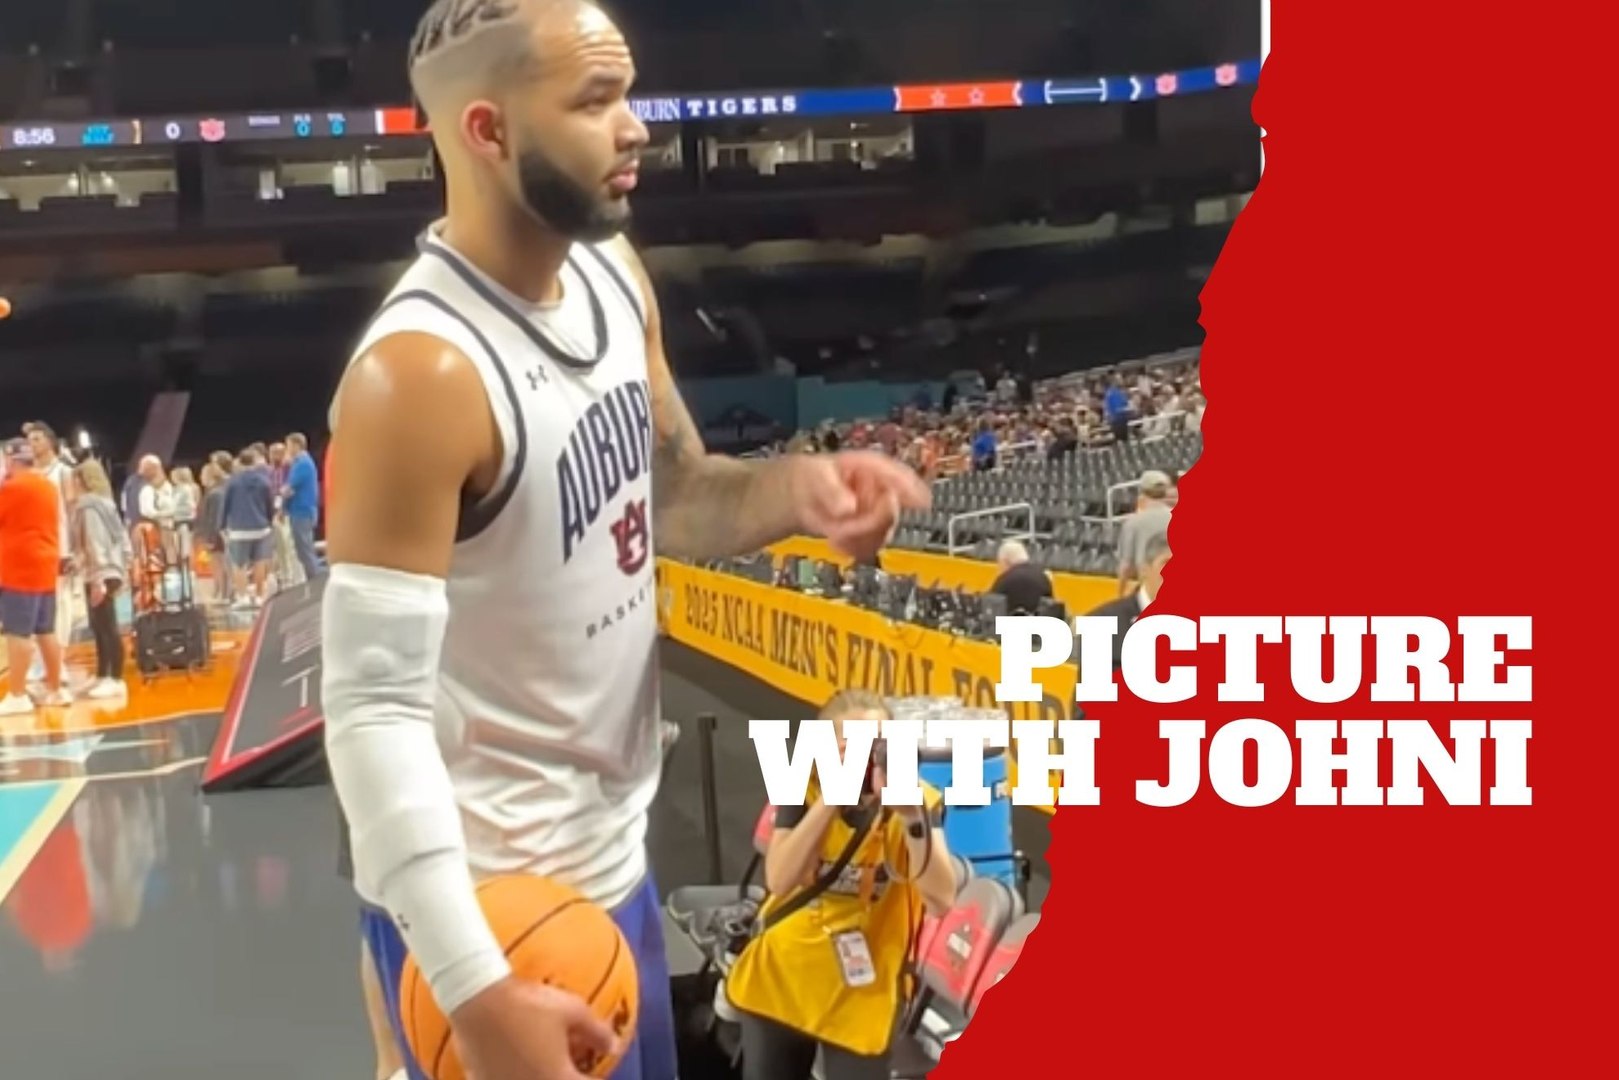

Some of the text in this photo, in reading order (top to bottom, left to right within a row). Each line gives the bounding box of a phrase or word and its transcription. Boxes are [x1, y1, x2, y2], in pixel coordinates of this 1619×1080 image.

[13, 127, 56, 146] 8:56
[628, 95, 797, 121] UBURN TIGERS
[556, 378, 650, 565] AUBUR
[685, 583, 718, 636] 2025
[722, 593, 766, 657] NCAA
[770, 608, 839, 687] MEN'S
